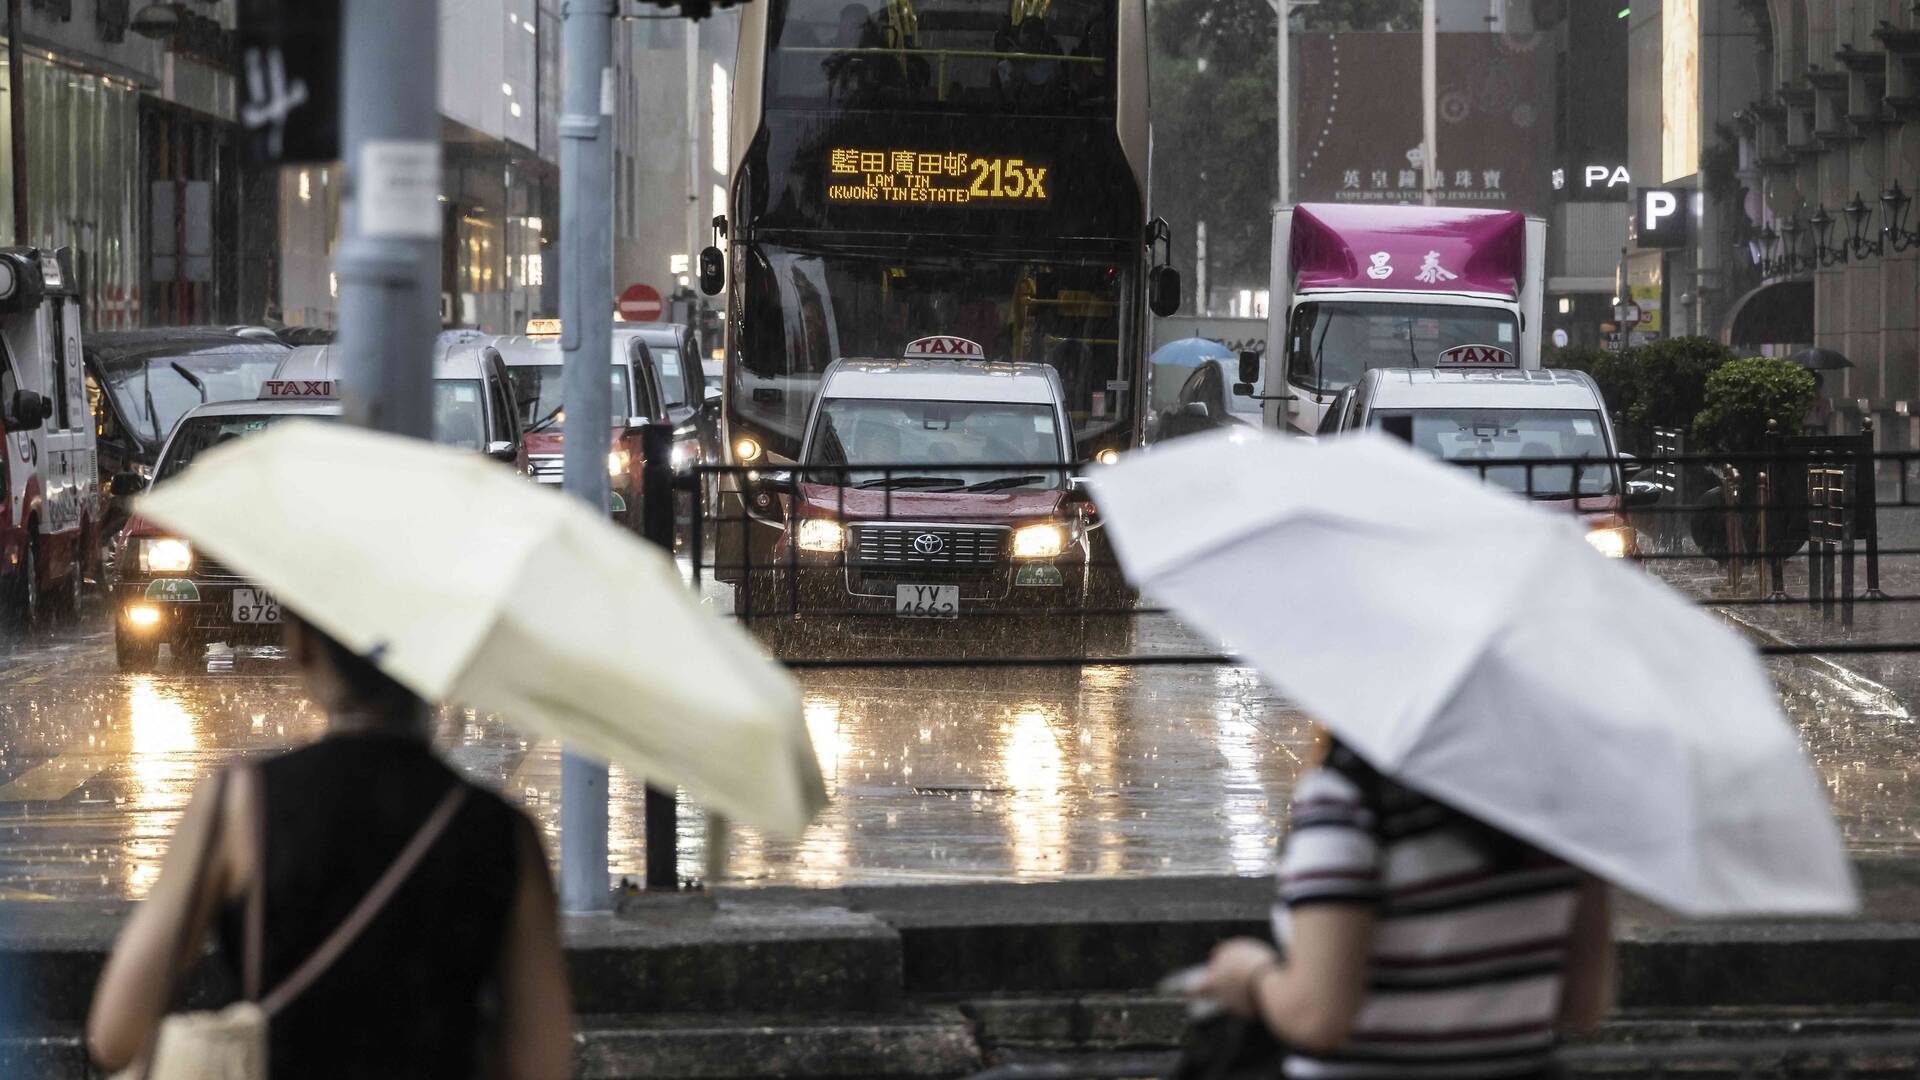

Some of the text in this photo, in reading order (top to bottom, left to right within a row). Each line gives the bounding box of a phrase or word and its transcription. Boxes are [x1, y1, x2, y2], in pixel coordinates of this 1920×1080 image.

[831, 149, 967, 176] 藍田廣田邨
[867, 173, 929, 188] LAM TIN
[829, 186, 970, 202] (KWONG TIN ESTATE)
[1646, 191, 1676, 230] P
[1366, 250, 1459, 284] 昌泰
[916, 338, 974, 355] TAXI
[1447, 348, 1505, 363] TAXI
[266, 381, 331, 396] TAXI
[166, 582, 177, 593] 4
[914, 586, 941, 602] YV
[238, 605, 278, 622] 876
[902, 601, 955, 618] 4662
